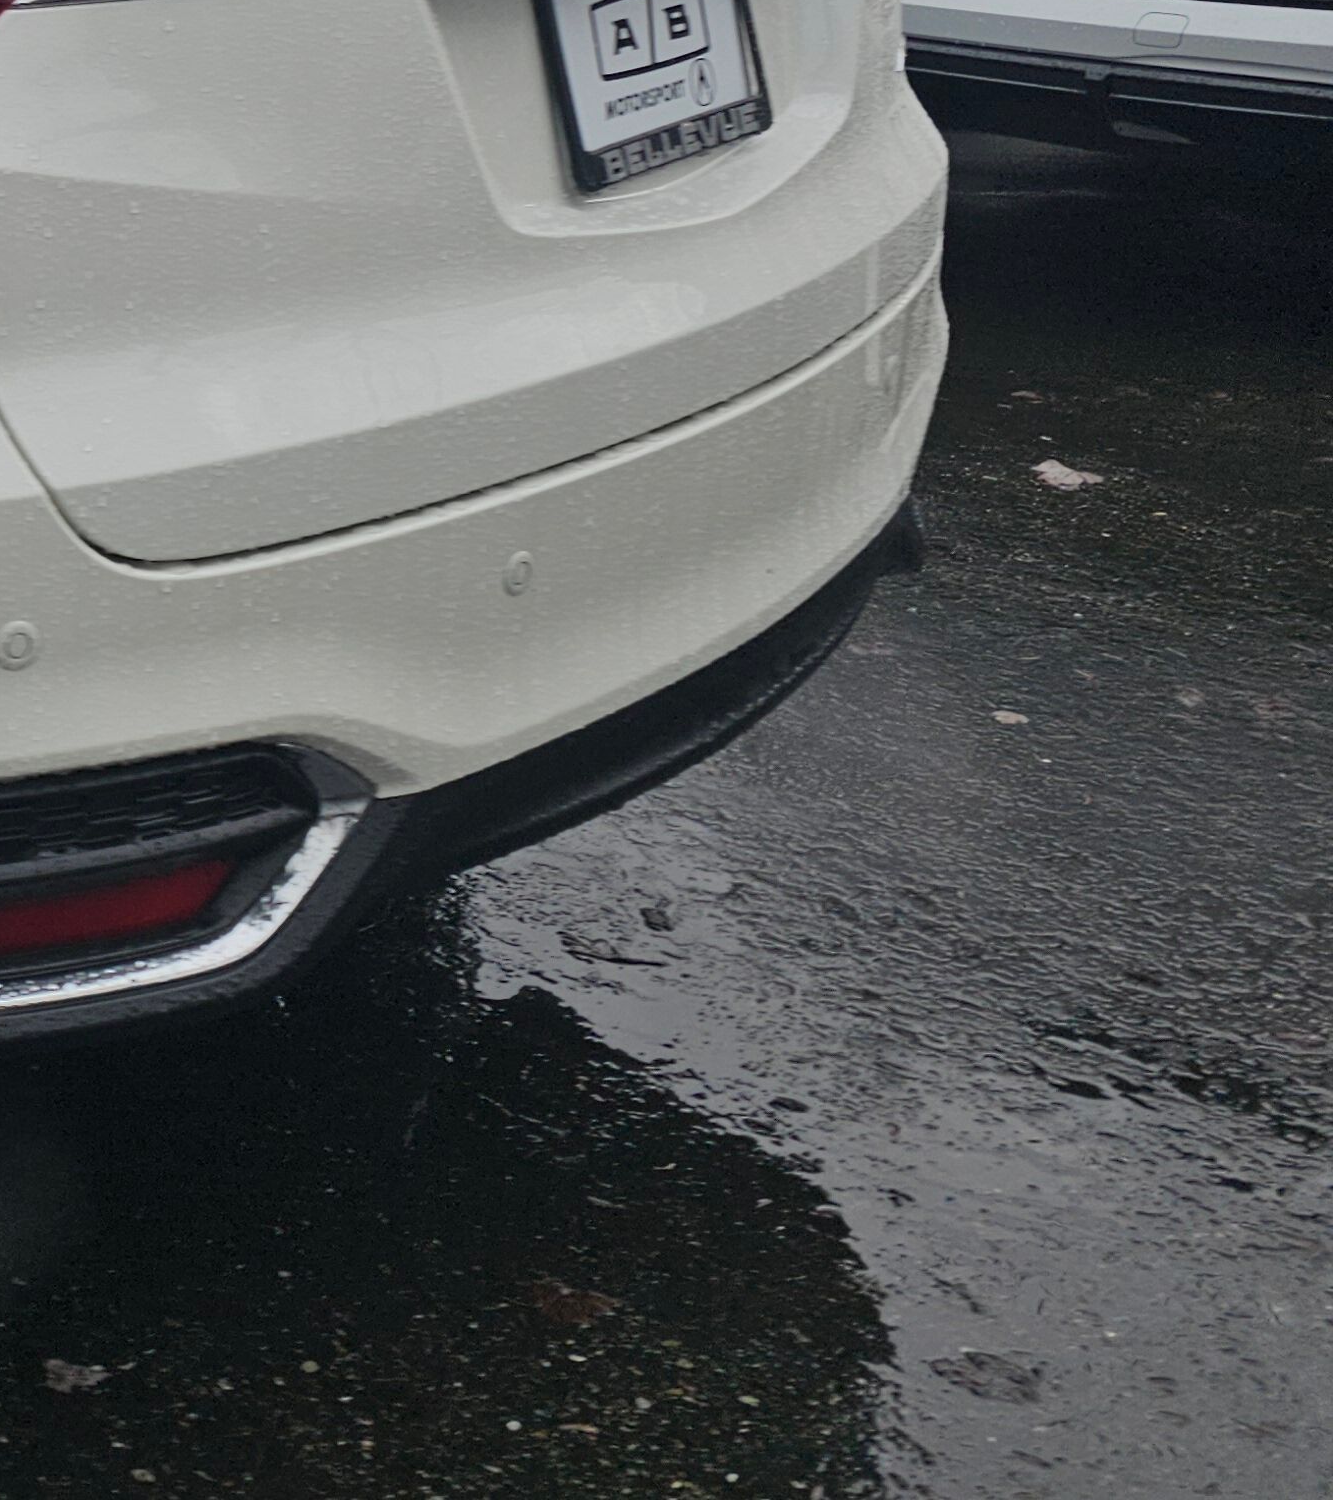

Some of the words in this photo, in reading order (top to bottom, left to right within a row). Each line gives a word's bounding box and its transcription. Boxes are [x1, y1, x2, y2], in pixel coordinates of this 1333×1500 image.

[612, 18, 639, 55] A
[662, 4, 691, 40] B
[606, 80, 686, 118] MOTORSPORT
[603, 103, 760, 182] BELLEVUE
